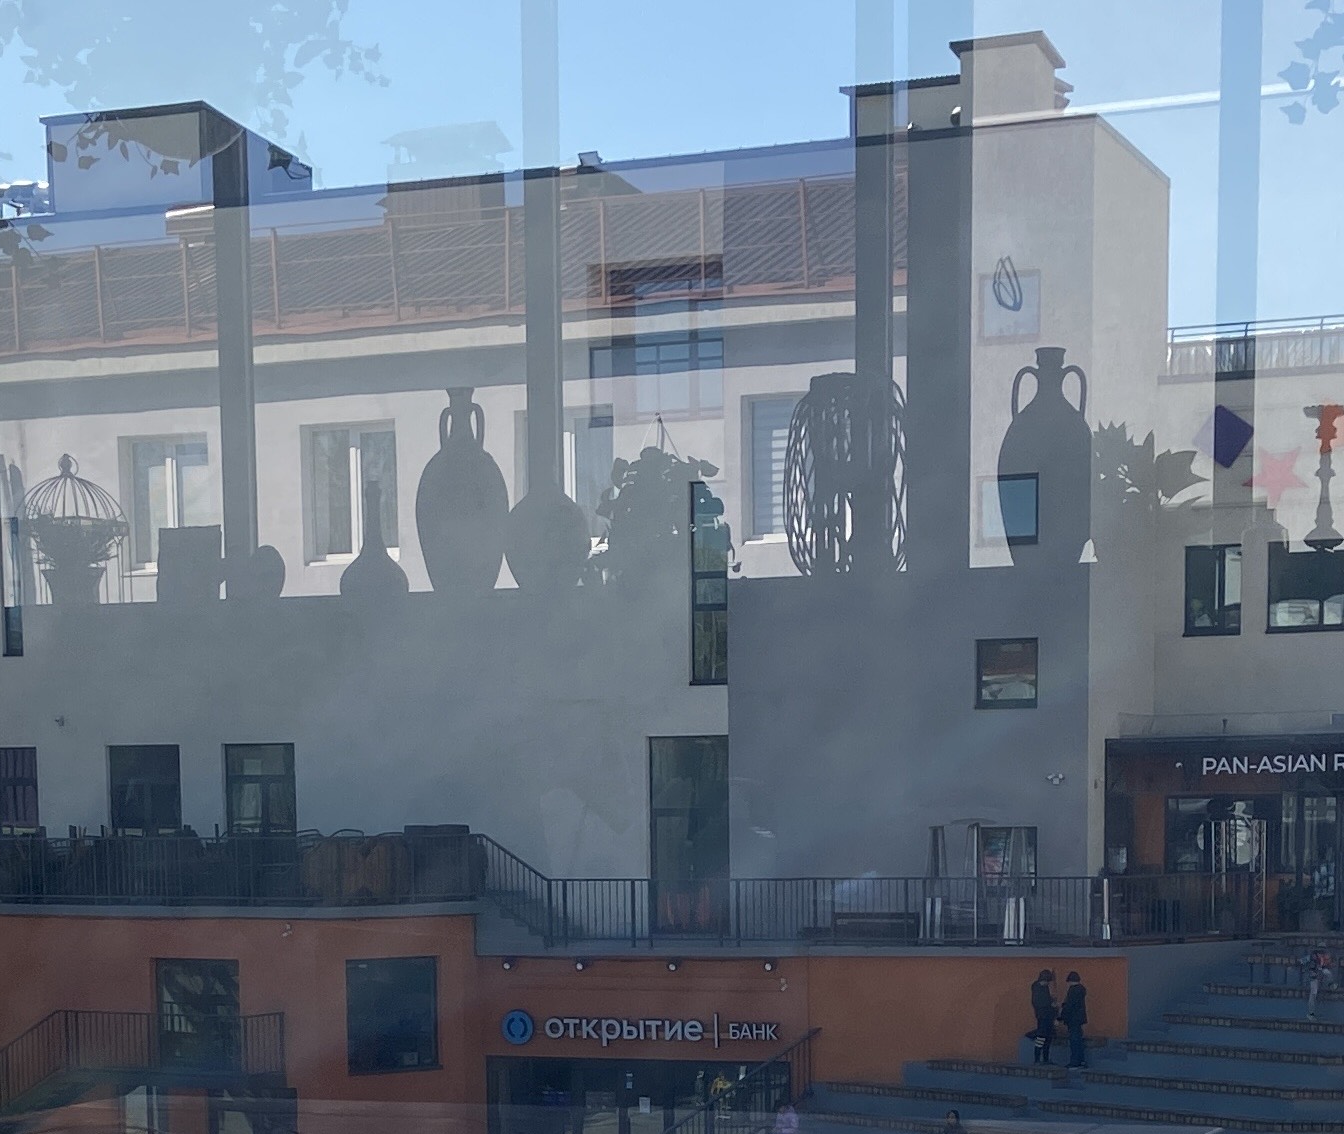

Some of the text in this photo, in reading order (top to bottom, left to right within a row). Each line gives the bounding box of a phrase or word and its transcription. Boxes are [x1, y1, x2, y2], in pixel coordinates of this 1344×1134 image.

[1202, 752, 1327, 776] PAN-ASIAN
[544, 1016, 779, 1047] открытие БАНК
